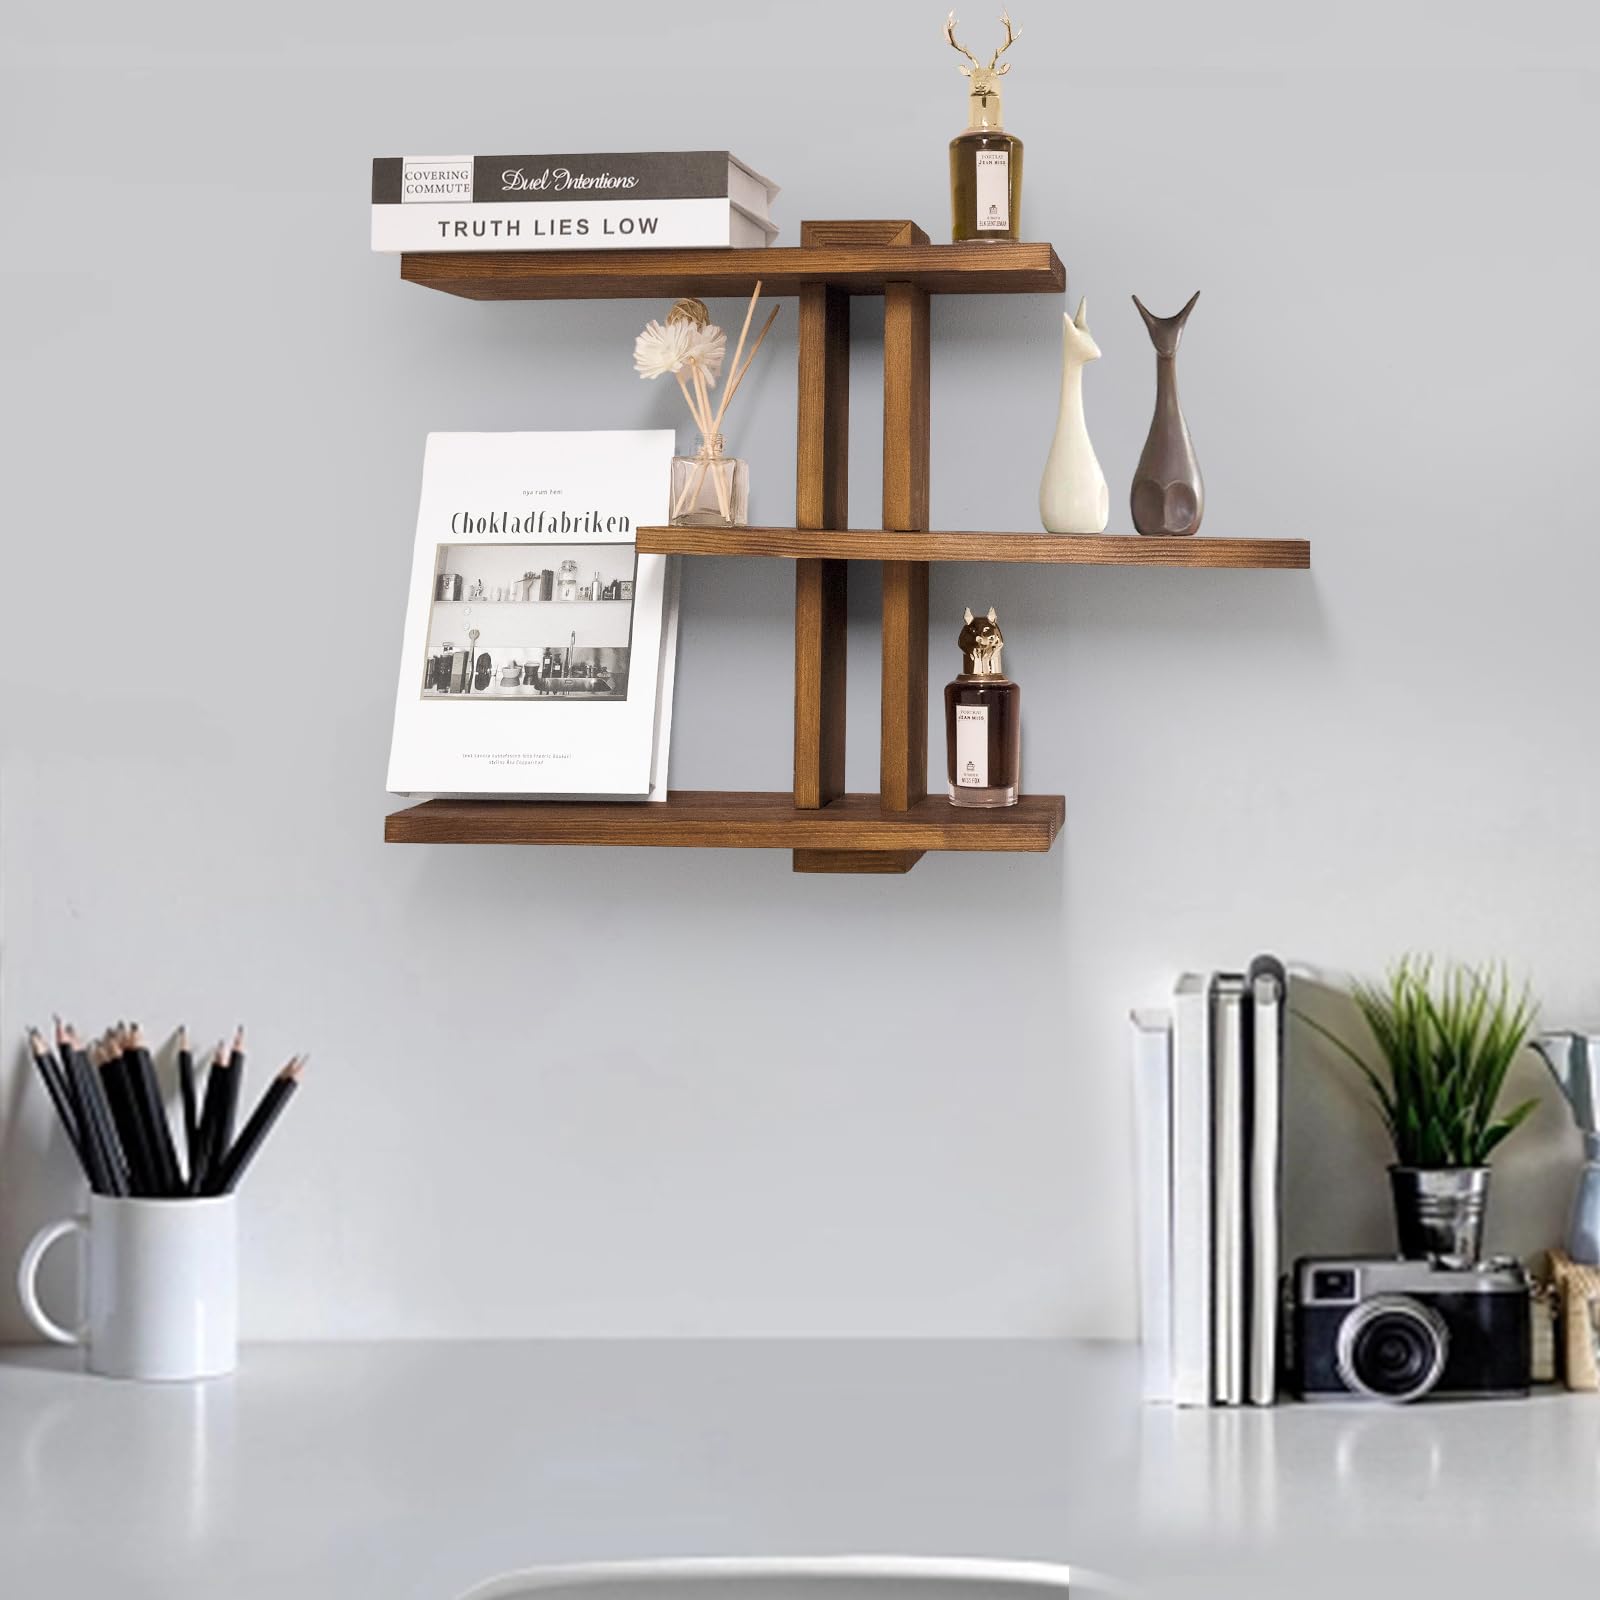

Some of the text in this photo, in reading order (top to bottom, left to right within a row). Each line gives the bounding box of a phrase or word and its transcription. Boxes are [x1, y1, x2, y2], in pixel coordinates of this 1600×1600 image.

[405, 170, 469, 182] COVERING
[501, 167, 640, 192] Duel Intentions
[406, 182, 471, 195] COMMUTE
[437, 216, 660, 238] TRUTH LIES LOW
[451, 510, 631, 535] Chokladfabriken
